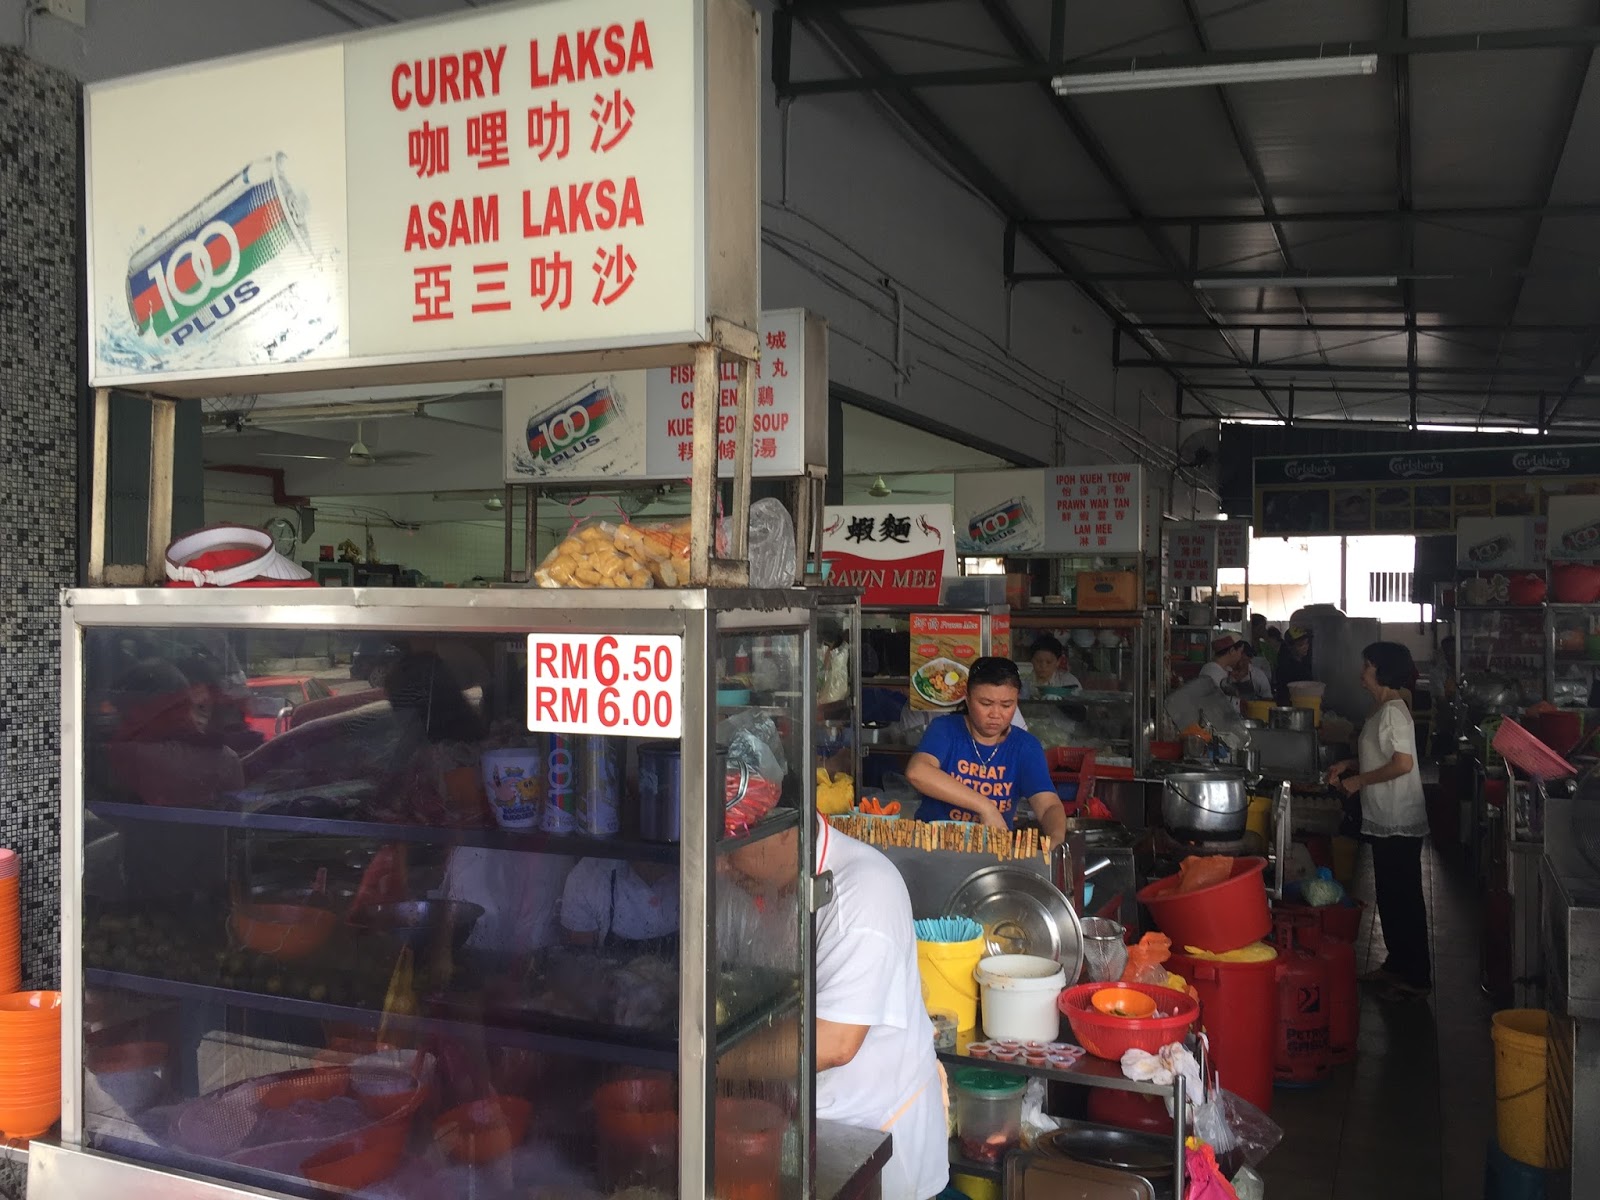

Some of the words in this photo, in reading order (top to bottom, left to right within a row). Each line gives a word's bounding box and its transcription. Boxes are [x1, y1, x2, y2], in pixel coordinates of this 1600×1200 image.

[391, 46, 506, 111] CURRY
[530, 21, 654, 89] LAKSA
[408, 90, 635, 177] 咖哩叻沙
[404, 194, 499, 252] ASAM
[522, 176, 644, 238] LAKSA
[147, 220, 240, 322] 100
[412, 245, 637, 322] 亞三叻沙
[171, 280, 260, 346] PLUS
[538, 404, 590, 454] 100
[753, 413, 789, 432] SOUP
[551, 435, 600, 465] PLUS
[1284, 460, 1336, 479] Carlsberg
[1388, 455, 1444, 476] Carlsberg
[1512, 451, 1570, 473] Carlsberg
[1056, 475, 1076, 485] IPOH
[1080, 473, 1103, 484] KUEH
[1107, 472, 1131, 483] TEOW
[1057, 499, 1086, 510] PRAWN
[1090, 498, 1109, 509] WAN
[1113, 497, 1130, 508] TAN
[845, 513, 912, 544] 蝦麵
[976, 512, 1010, 539] 100
[1074, 525, 1091, 535] LAM
[1095, 524, 1113, 534] MEE
[827, 569, 886, 588] RAWN
[891, 569, 937, 588] MEE
[957, 759, 1007, 780] GREAT
